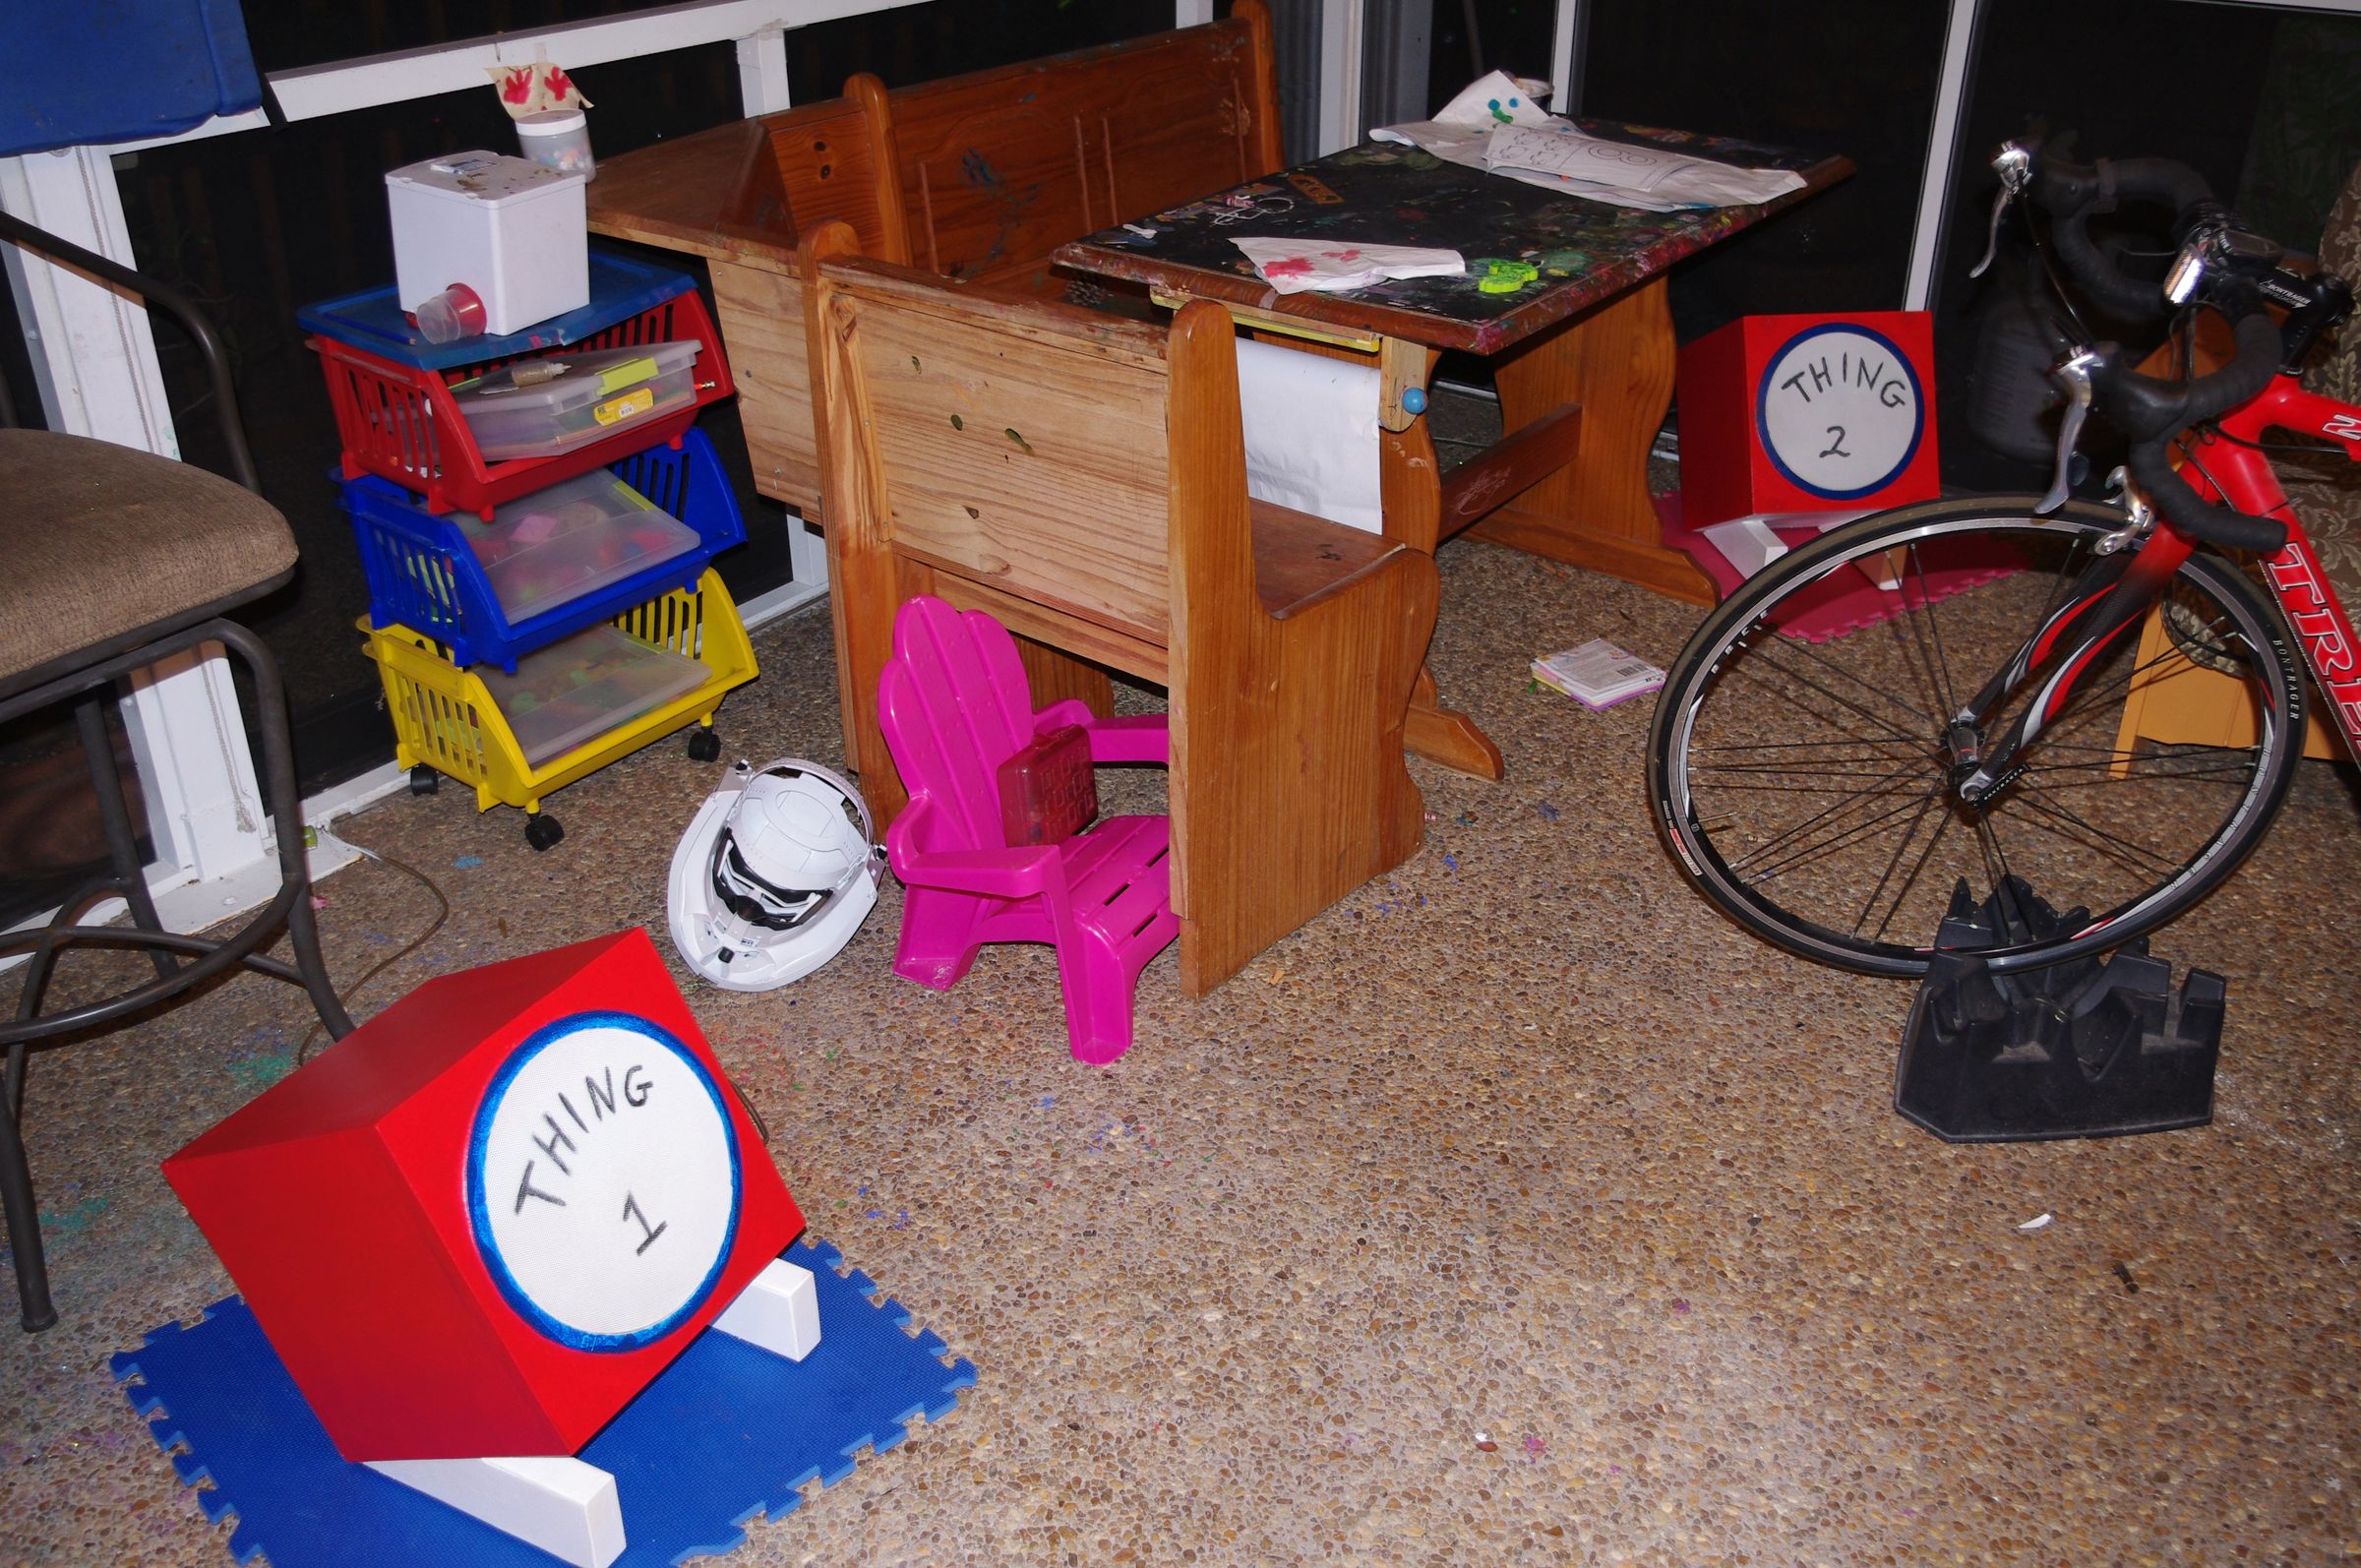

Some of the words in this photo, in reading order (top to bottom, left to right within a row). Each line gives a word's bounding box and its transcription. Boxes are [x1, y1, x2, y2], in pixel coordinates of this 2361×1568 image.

[1781, 351, 1907, 408] THING
[1819, 425, 1851, 458] 2
[2268, 542, 2361, 751] TRE
[2271, 637, 2300, 721] BONTRAGER
[2170, 748, 2272, 890] BONTRAGER
[515, 1064, 654, 1215] THING
[623, 1190, 668, 1256] 1
